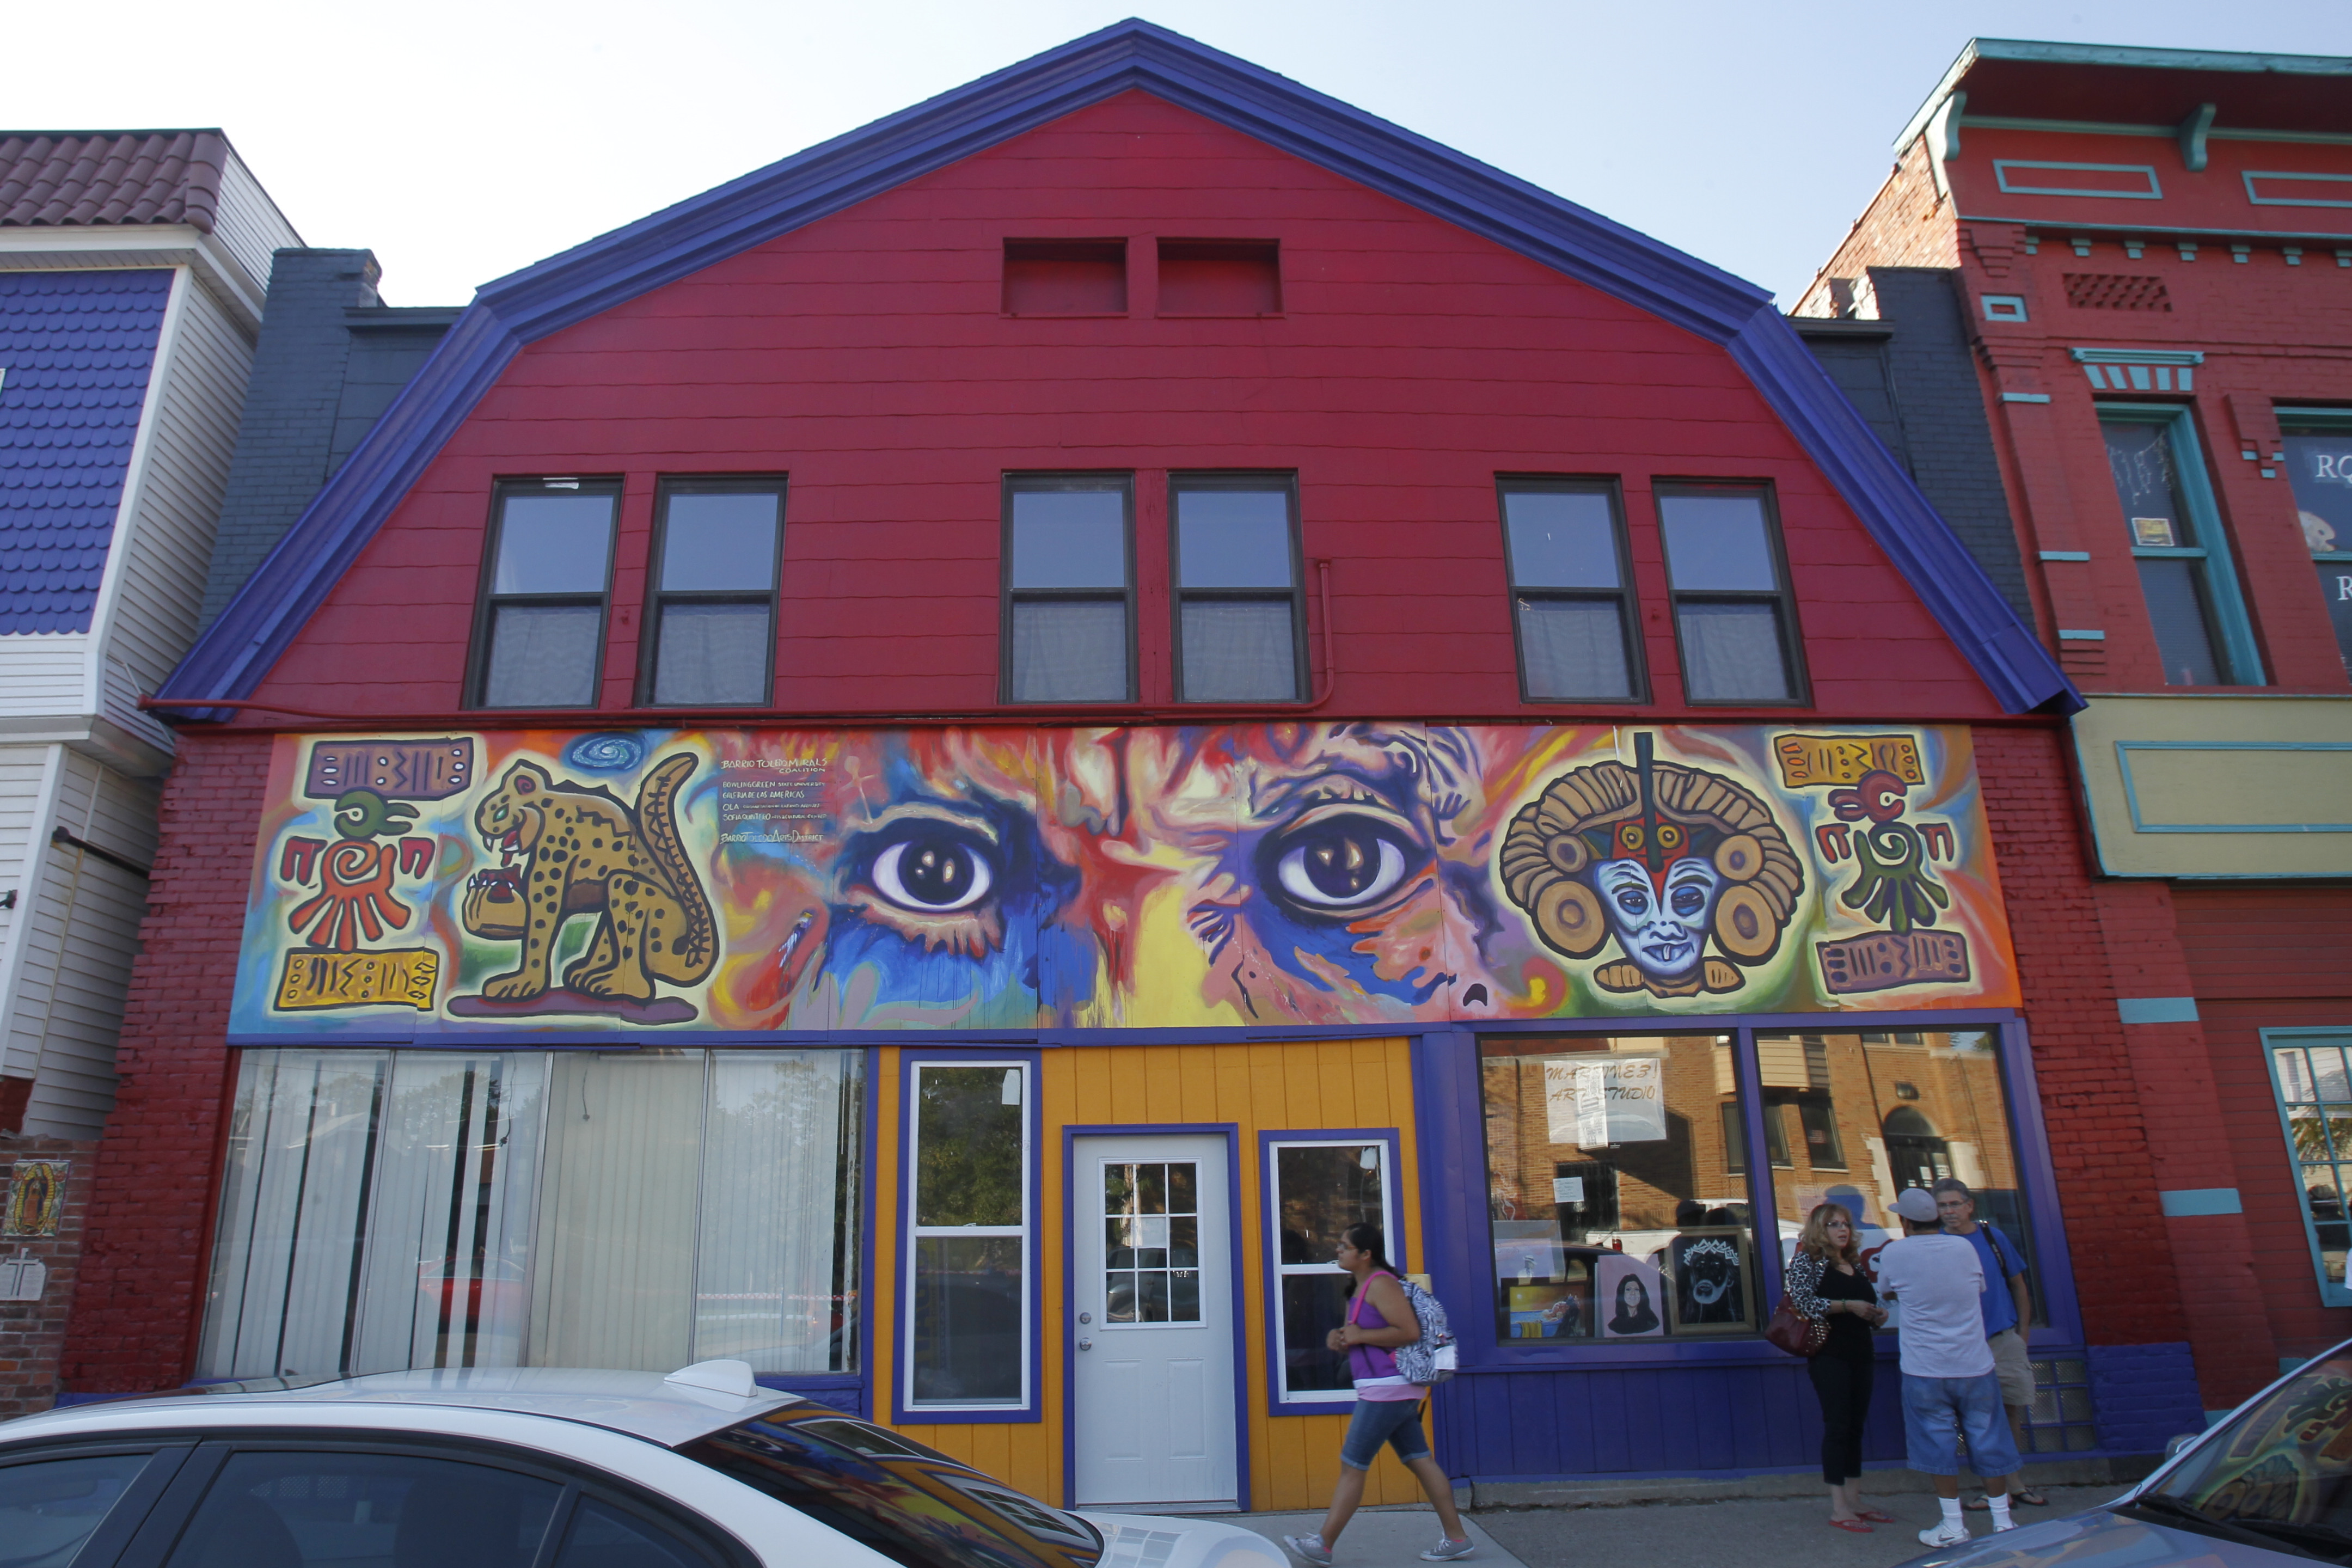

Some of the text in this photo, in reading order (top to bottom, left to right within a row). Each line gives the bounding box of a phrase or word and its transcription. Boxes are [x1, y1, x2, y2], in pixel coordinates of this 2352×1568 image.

[720, 758, 828, 769] BARRIO TOLEDO MURALS
[756, 790, 768, 799] LAS
[769, 789, 805, 799] AMERICAS
[722, 803, 739, 811] OLA
